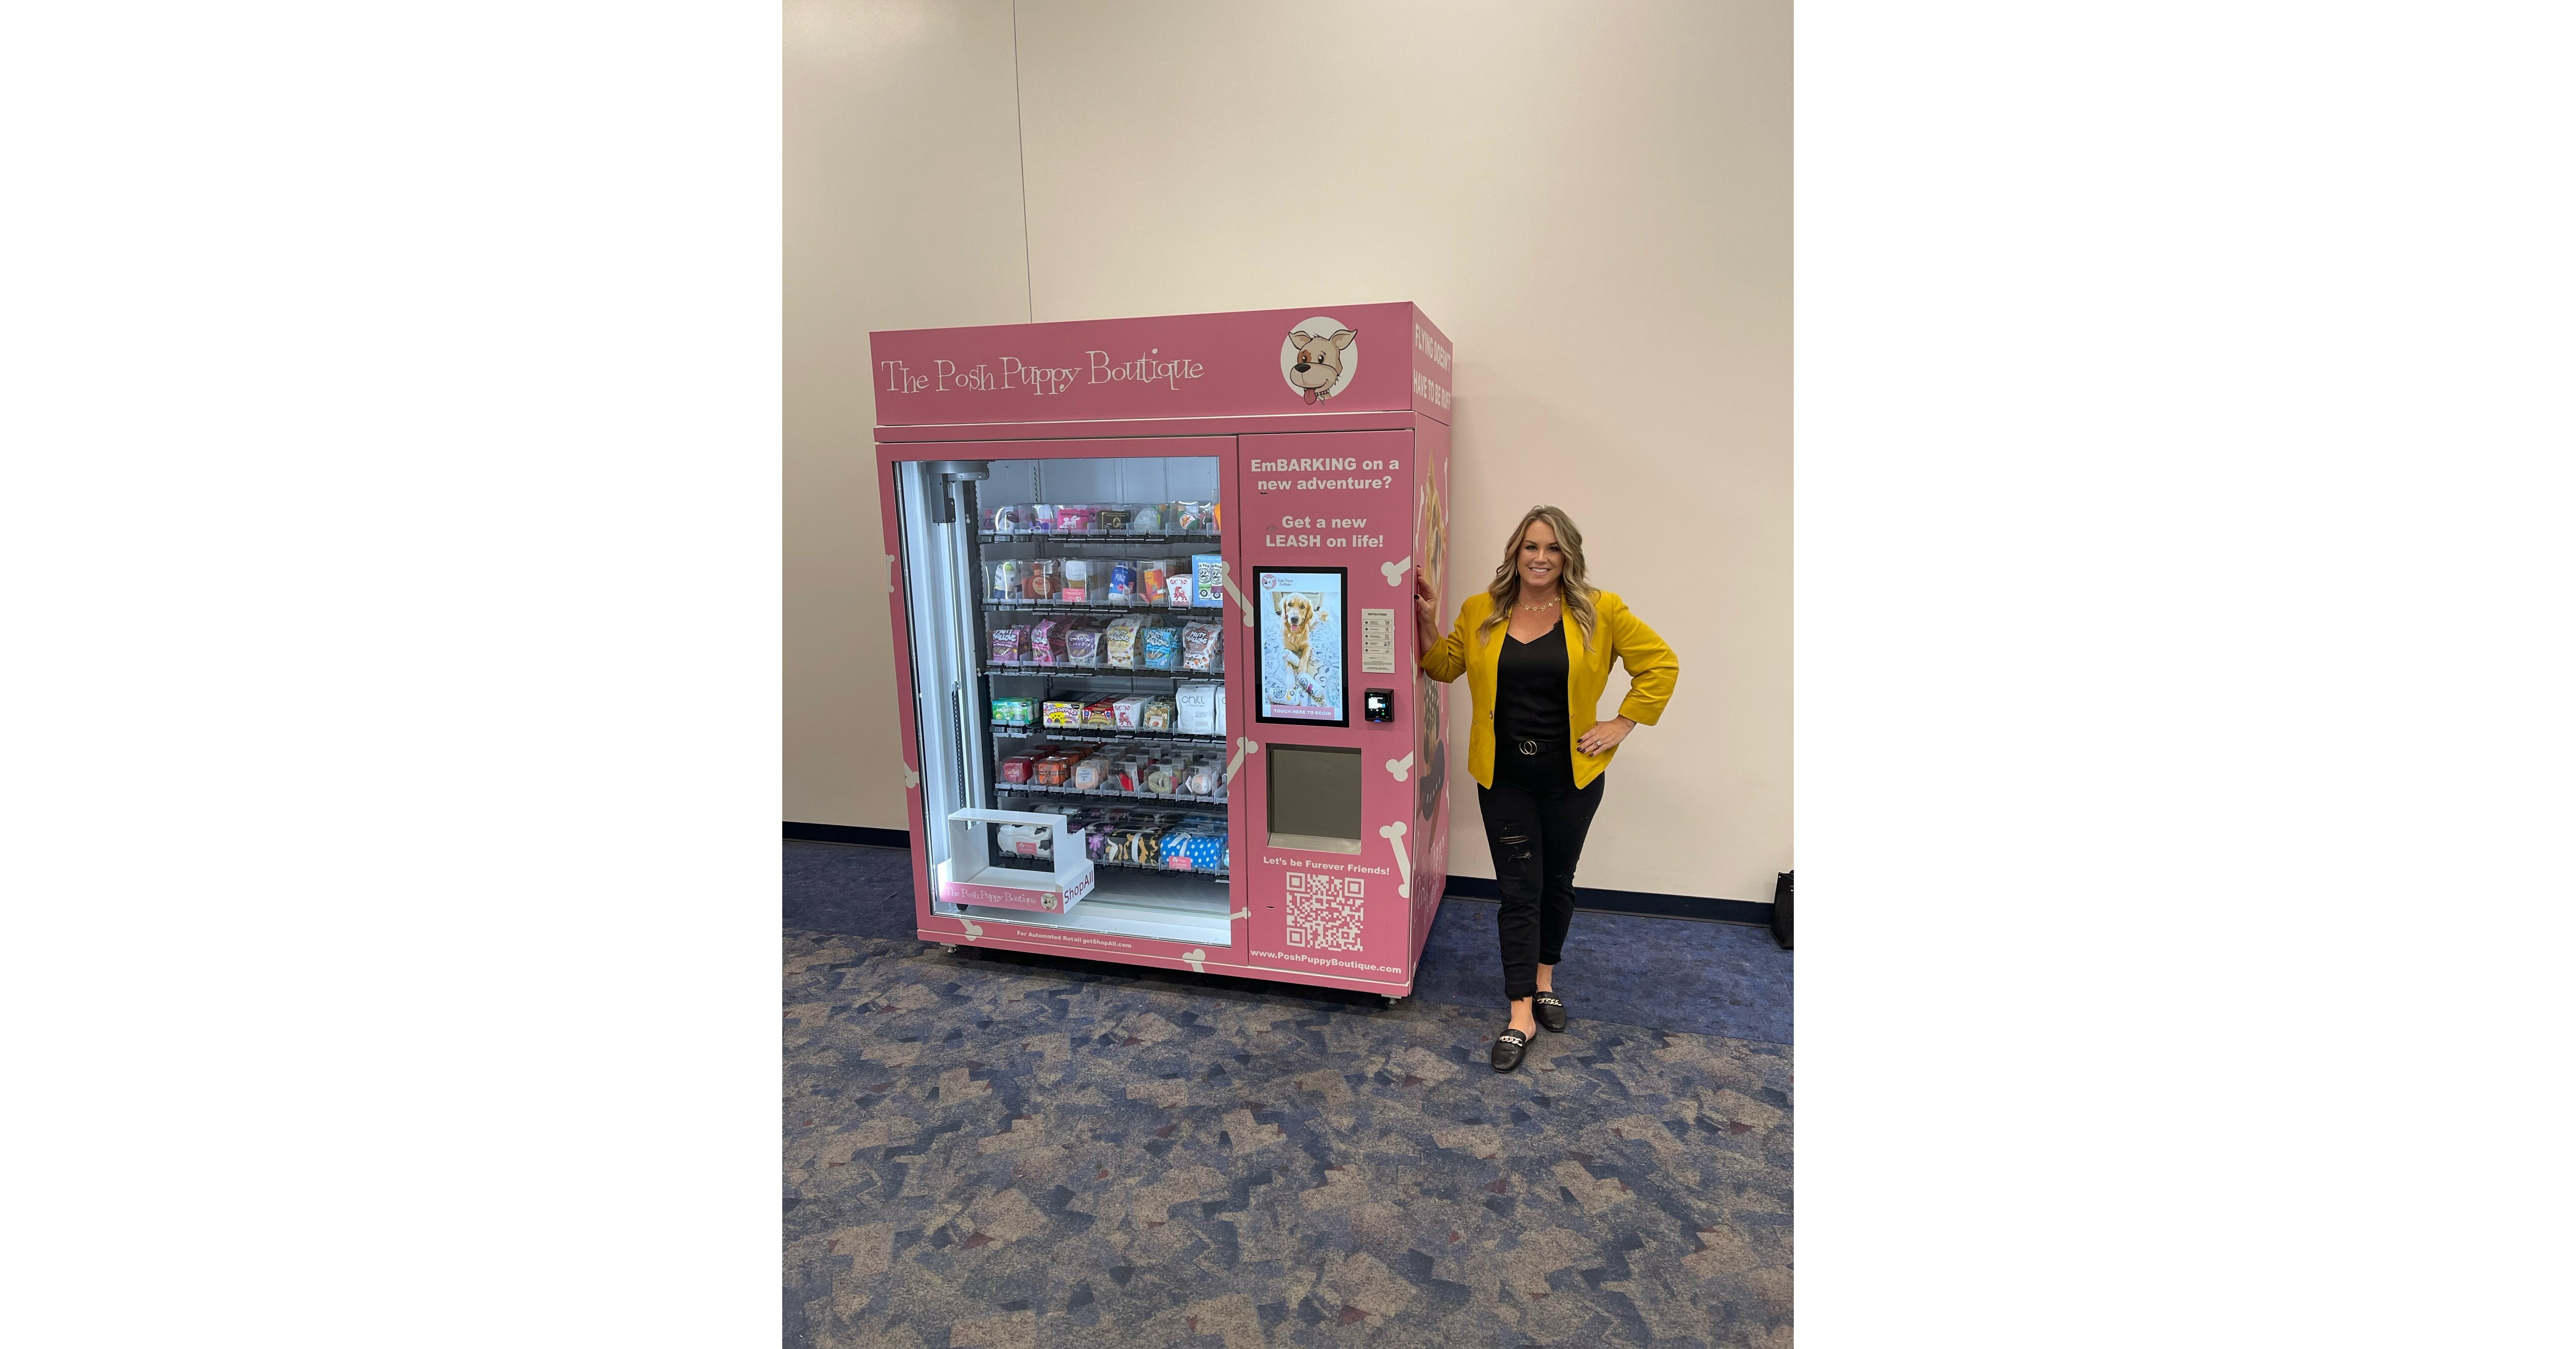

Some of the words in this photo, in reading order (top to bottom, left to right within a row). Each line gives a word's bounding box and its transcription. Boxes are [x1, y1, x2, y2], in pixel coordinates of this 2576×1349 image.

[1415, 323, 1433, 359] FLYING
[1434, 341, 1451, 373] DOESN'T
[882, 360, 929, 393] The
[934, 360, 998, 392] Posh
[999, 356, 1082, 395] Puppy
[1085, 348, 1205, 391] Boutique
[1414, 369, 1427, 399] HAVE
[1428, 379, 1434, 403] TO
[1435, 384, 1441, 406] BE
[1442, 388, 1451, 411] RUFF
[1251, 458, 1357, 472] EmBARKING
[1362, 460, 1383, 470] on
[1389, 460, 1400, 470] a
[1258, 479, 1292, 490] new
[1297, 476, 1392, 490] adventure?
[1282, 516, 1311, 528] Get
[1316, 519, 1326, 528] a
[1332, 518, 1367, 528] new
[1266, 535, 1321, 547] LEASH
[1326, 538, 1347, 548] on
[1352, 535, 1384, 547] life!
[1181, 695, 1205, 704] chill
[1263, 856, 1287, 865] Let's
[1306, 860, 1344, 871] Furever
[1348, 864, 1390, 875] Friends!
[945, 886, 960, 897] The
[961, 889, 979, 899] Posh
[980, 890, 1003, 903] Puppy
[1005, 892, 1037, 906] Boutique
[1063, 869, 1094, 904] ShopAll
[1082, 939, 1132, 948] getShopAll.com
[1250, 950, 1402, 974] www.PoshPuppyBoutique.com
